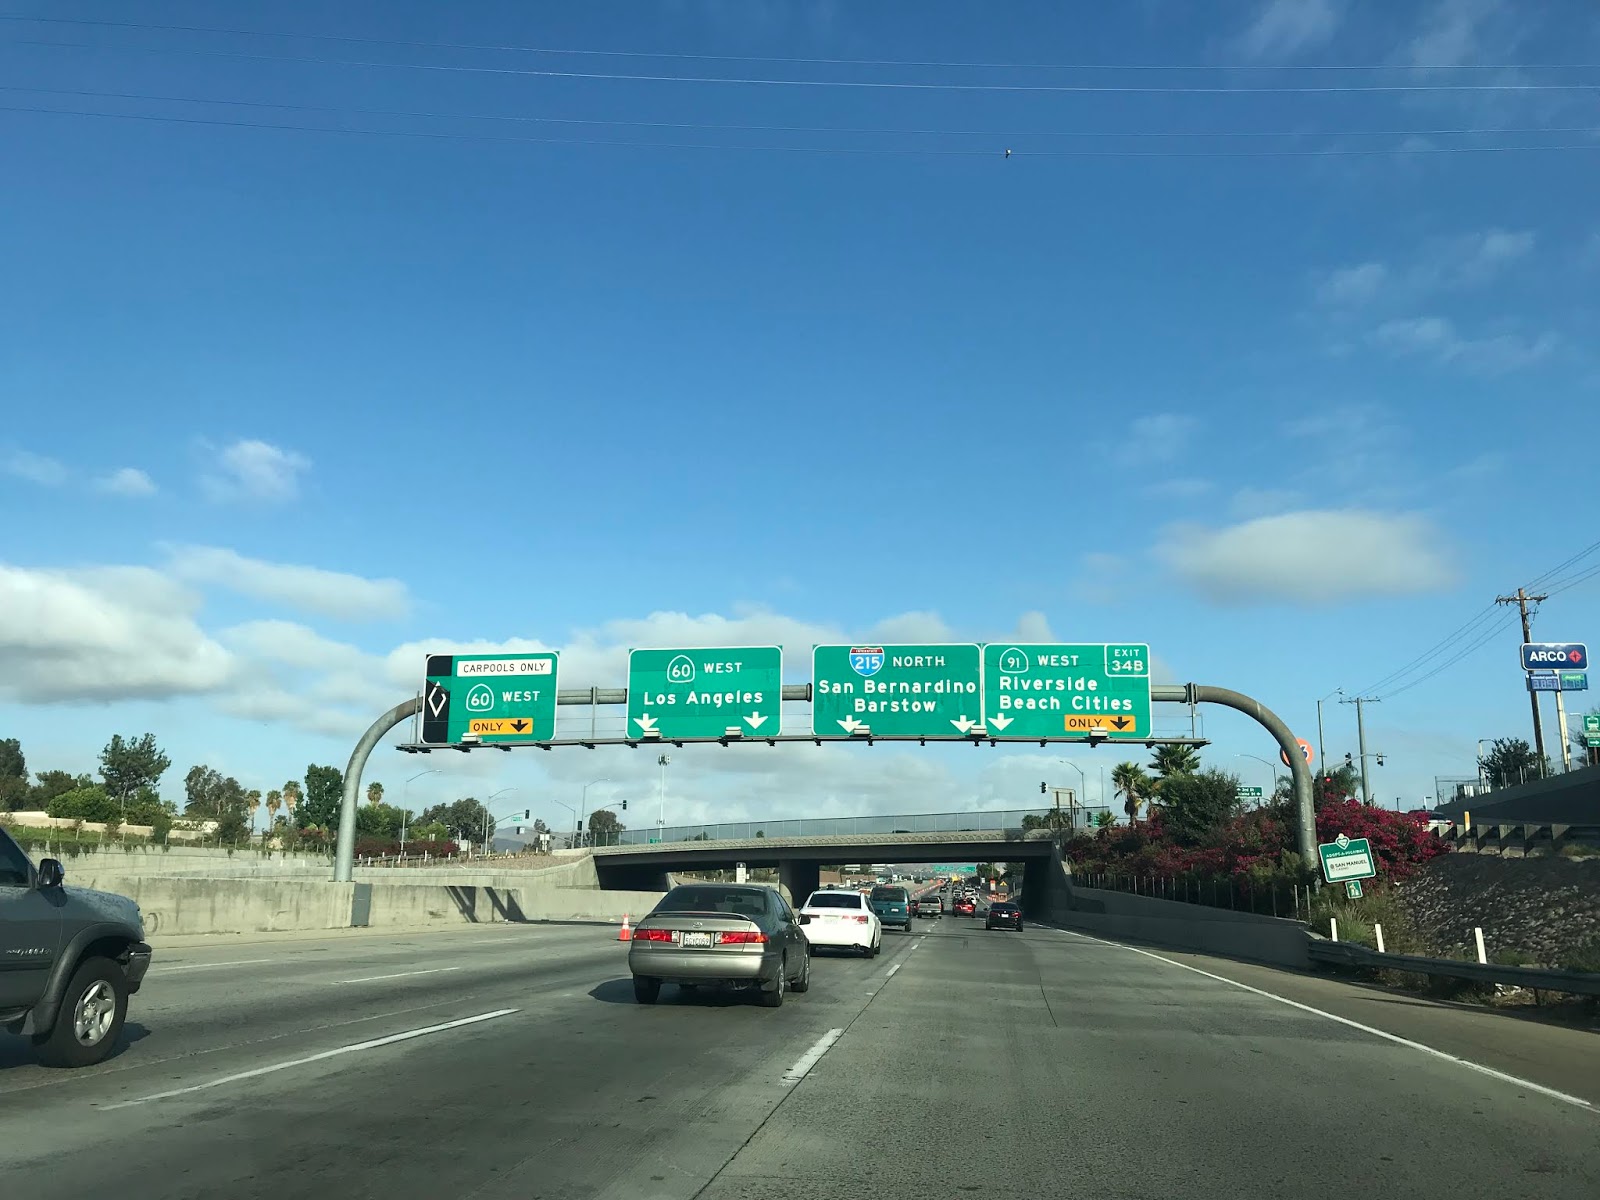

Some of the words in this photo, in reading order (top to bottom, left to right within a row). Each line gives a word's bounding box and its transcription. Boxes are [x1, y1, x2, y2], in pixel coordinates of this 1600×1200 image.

[1114, 648, 1140, 657] EXIT
[1529, 651, 1566, 662] ARCO
[463, 662, 515, 674] CARPOOLS
[520, 661, 546, 673] ONLY
[855, 656, 881, 670] 215
[892, 655, 945, 667] NORTH
[1007, 656, 1021, 669] 91
[1037, 655, 1079, 667] WEST
[1111, 660, 1144, 672] 34B
[672, 664, 691, 678] 60
[703, 662, 743, 674] WEST
[819, 679, 854, 694] San
[864, 678, 977, 694] Bernardino
[999, 676, 1099, 691] Riverside
[470, 693, 489, 707] 60
[502, 690, 541, 703] WEST
[643, 691, 677, 706] Los
[686, 689, 764, 708] Angeles
[854, 698, 937, 713] Barstow
[999, 695, 1061, 710] Beach
[1071, 695, 1134, 711] Cities
[472, 721, 503, 732] ONLY
[1068, 718, 1102, 728] ONLY
